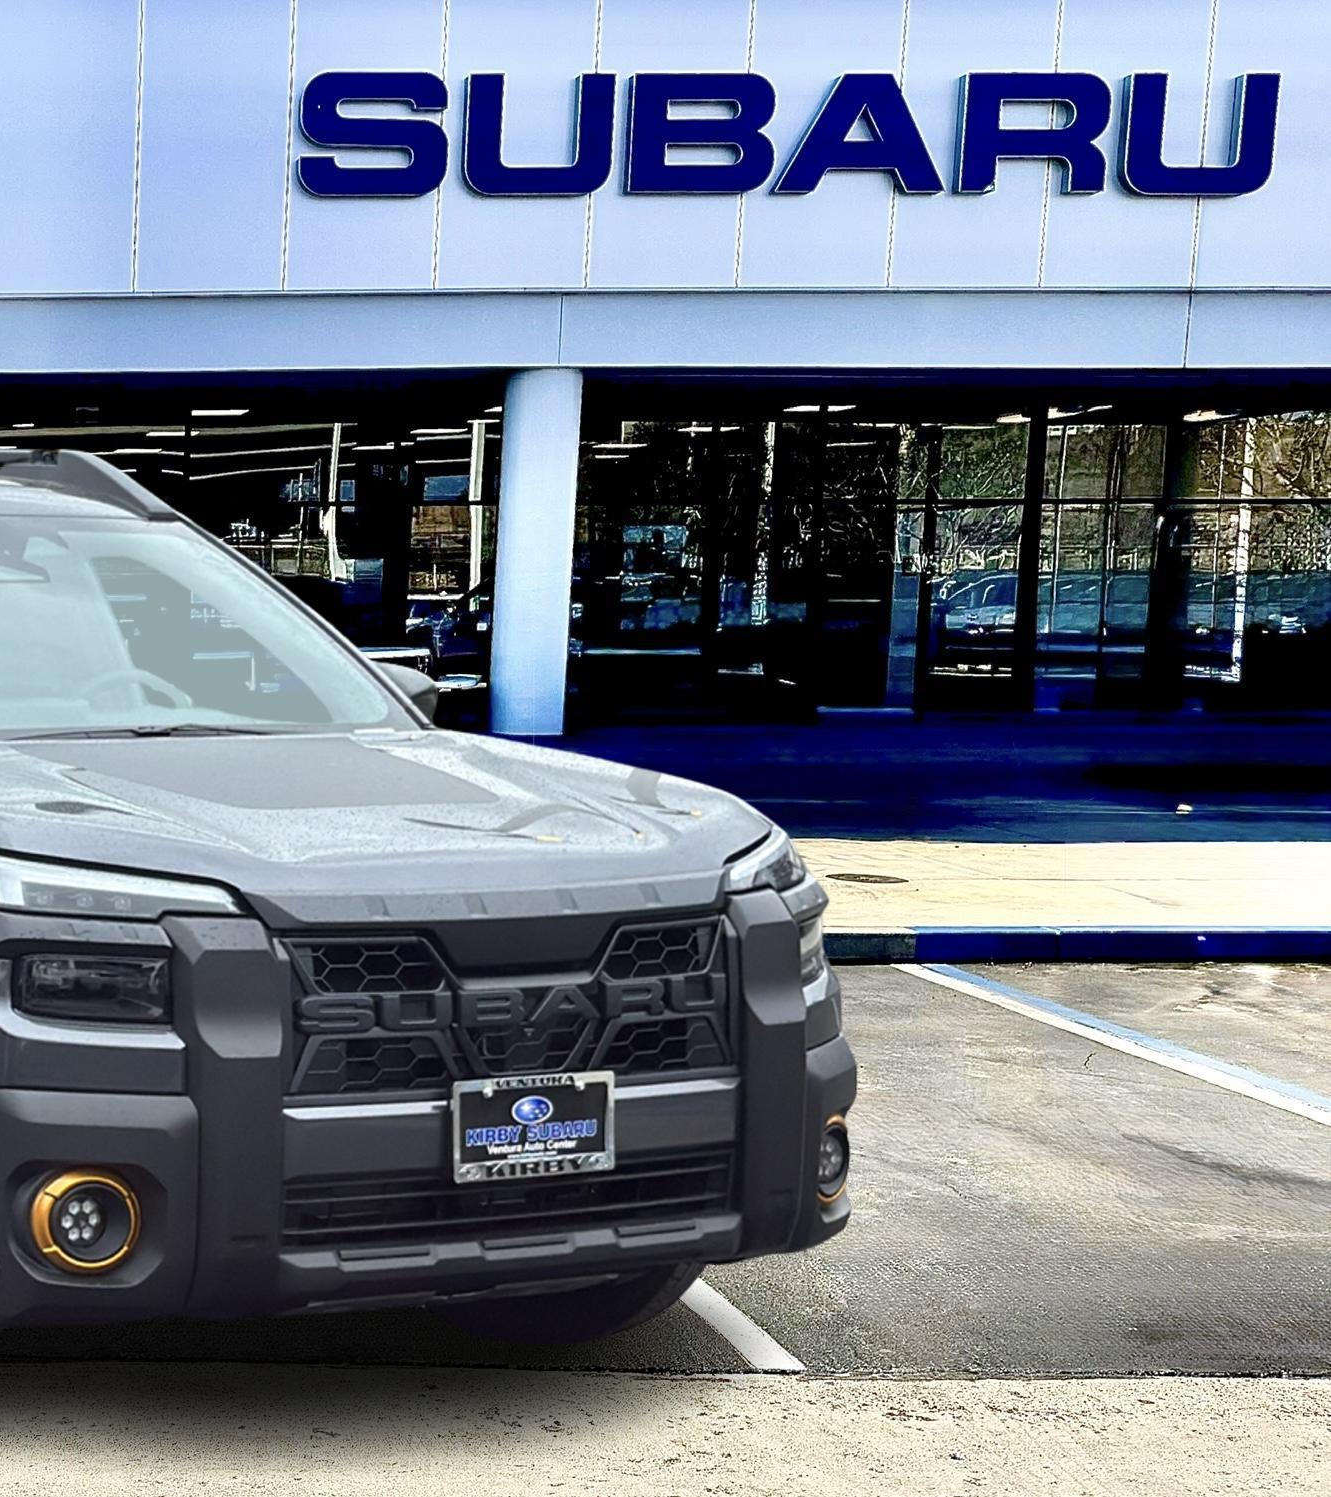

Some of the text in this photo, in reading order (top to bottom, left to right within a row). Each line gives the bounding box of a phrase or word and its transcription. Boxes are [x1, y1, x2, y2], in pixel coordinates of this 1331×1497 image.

[297, 69, 1282, 198] SUBARU
[298, 972, 726, 1033] SUBARU
[465, 1119, 598, 1147] KIRBY SUBARU
[487, 1143, 522, 1155] Ventura
[523, 1140, 545, 1152] Auto
[546, 1138, 578, 1150] Center
[486, 1155, 589, 1178] KIRBY
